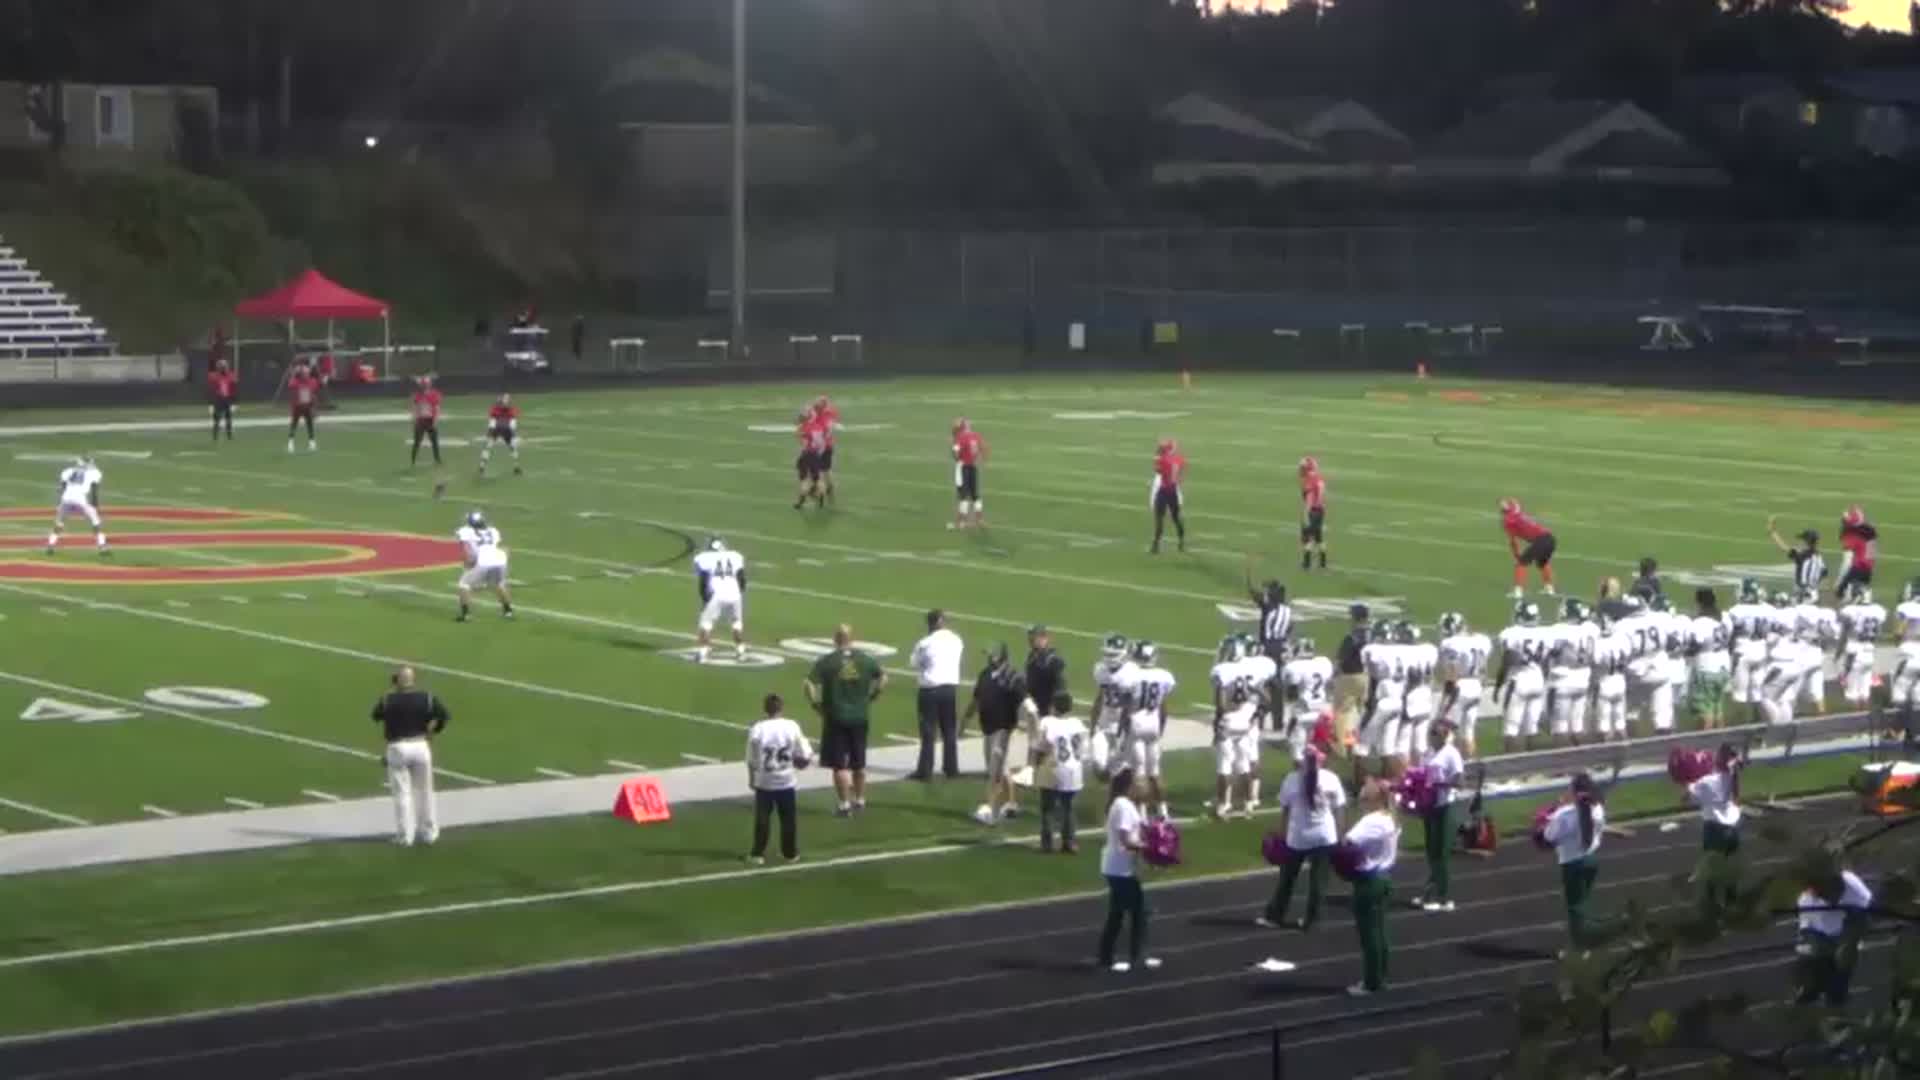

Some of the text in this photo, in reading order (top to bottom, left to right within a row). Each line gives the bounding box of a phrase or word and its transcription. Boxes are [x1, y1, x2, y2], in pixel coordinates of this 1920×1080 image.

[713, 557, 734, 580] 44
[1522, 639, 1544, 665] 54
[1634, 626, 1660, 655] 79
[1139, 680, 1159, 712] 18
[632, 784, 664, 814] 40
